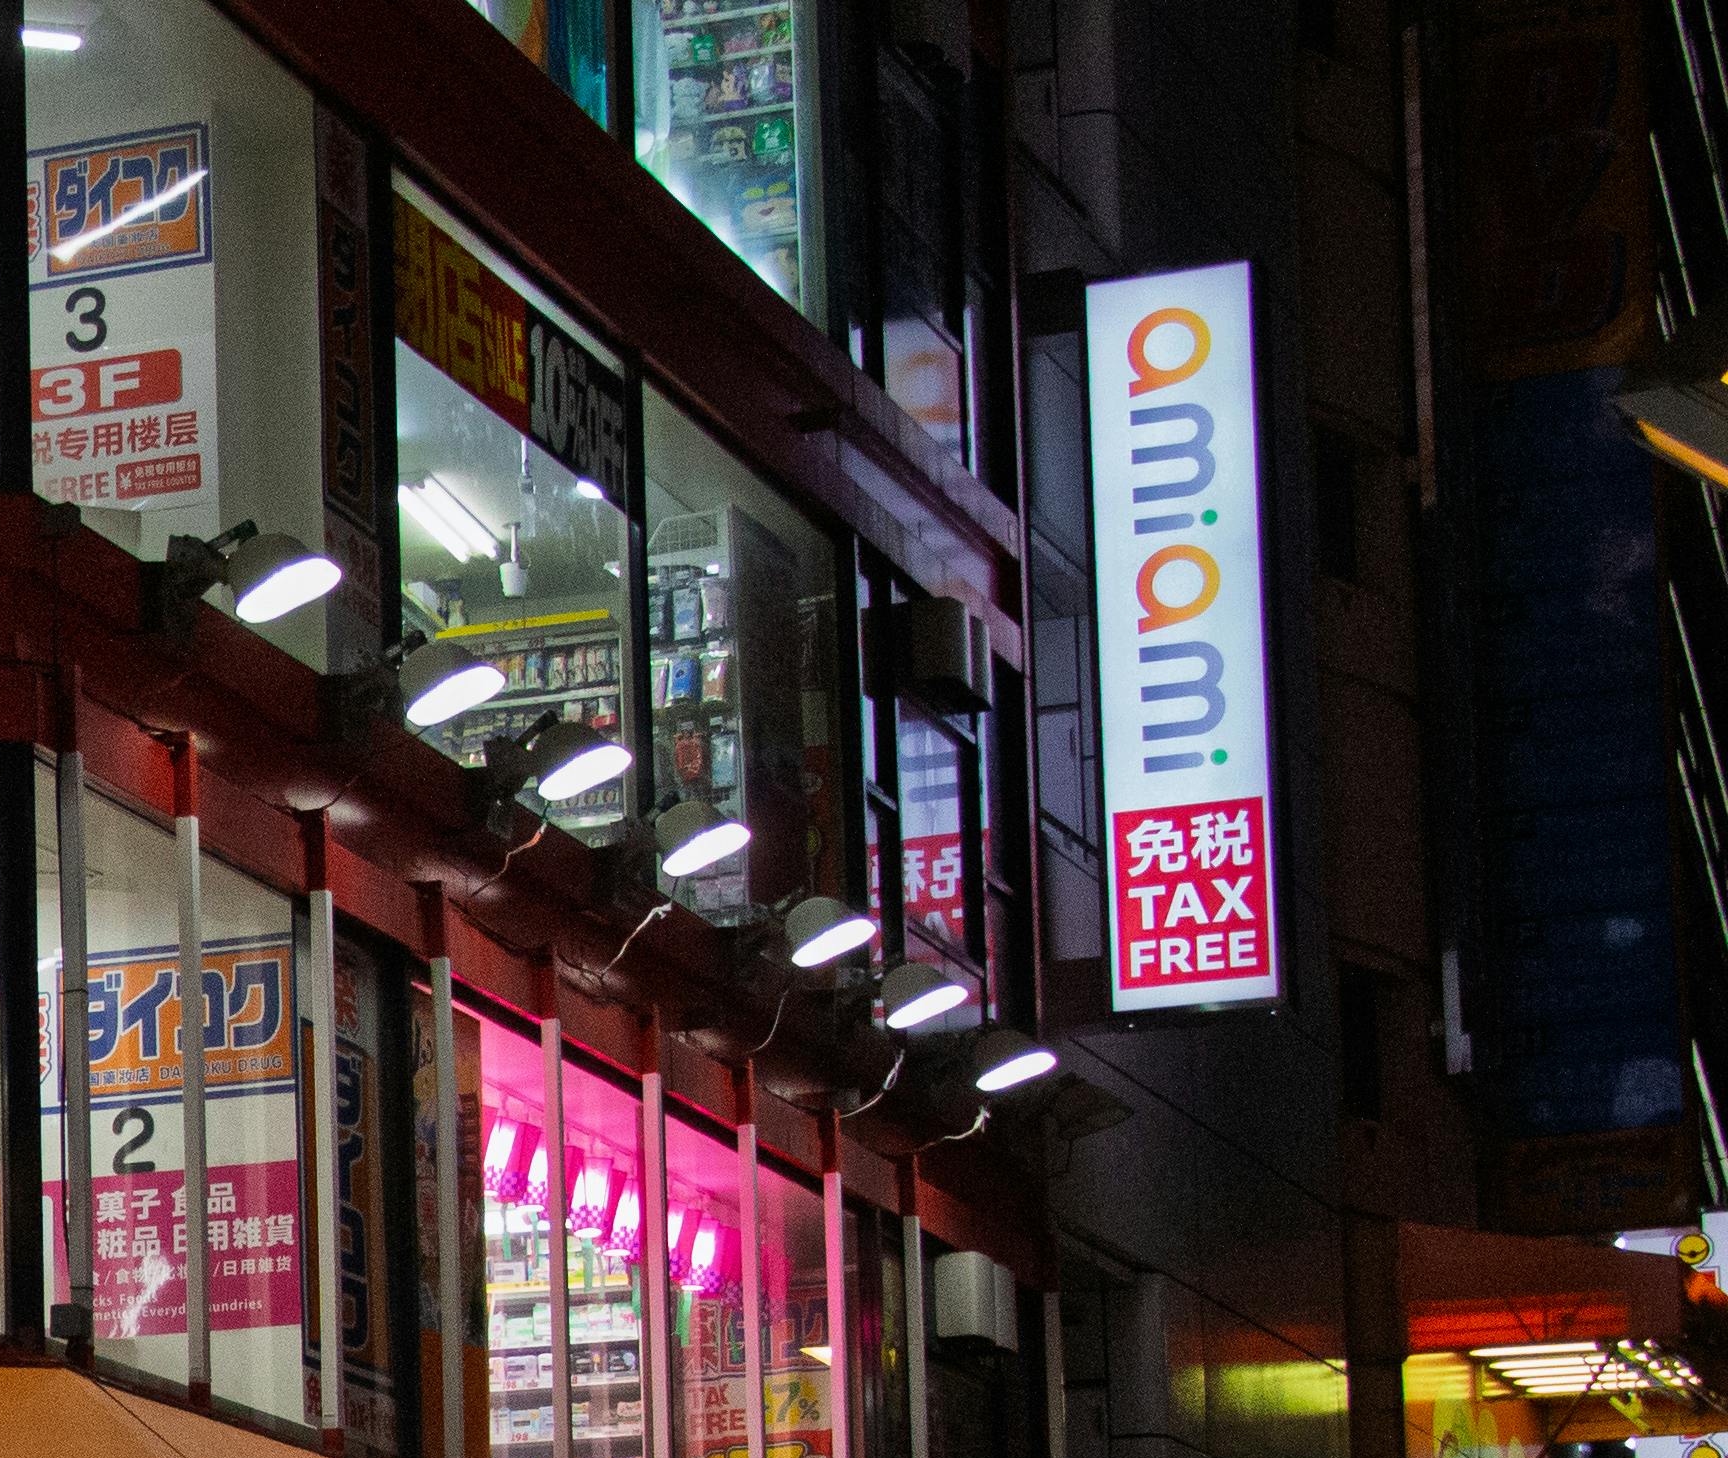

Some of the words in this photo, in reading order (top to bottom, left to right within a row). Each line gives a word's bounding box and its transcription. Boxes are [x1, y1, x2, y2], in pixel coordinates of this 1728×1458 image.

[55, 148, 189, 238] ダイコク
[65, 287, 107, 352] 3
[38, 360, 141, 416] 3F
[1126, 306, 1228, 776] amiami
[1127, 809, 1255, 875] 免税
[1129, 876, 1255, 931] TAX
[1129, 930, 1258, 978] FREE
[237, 1053, 283, 1075] DRUG
[112, 1107, 156, 1175] 2
[688, 1407, 747, 1436] FREE
